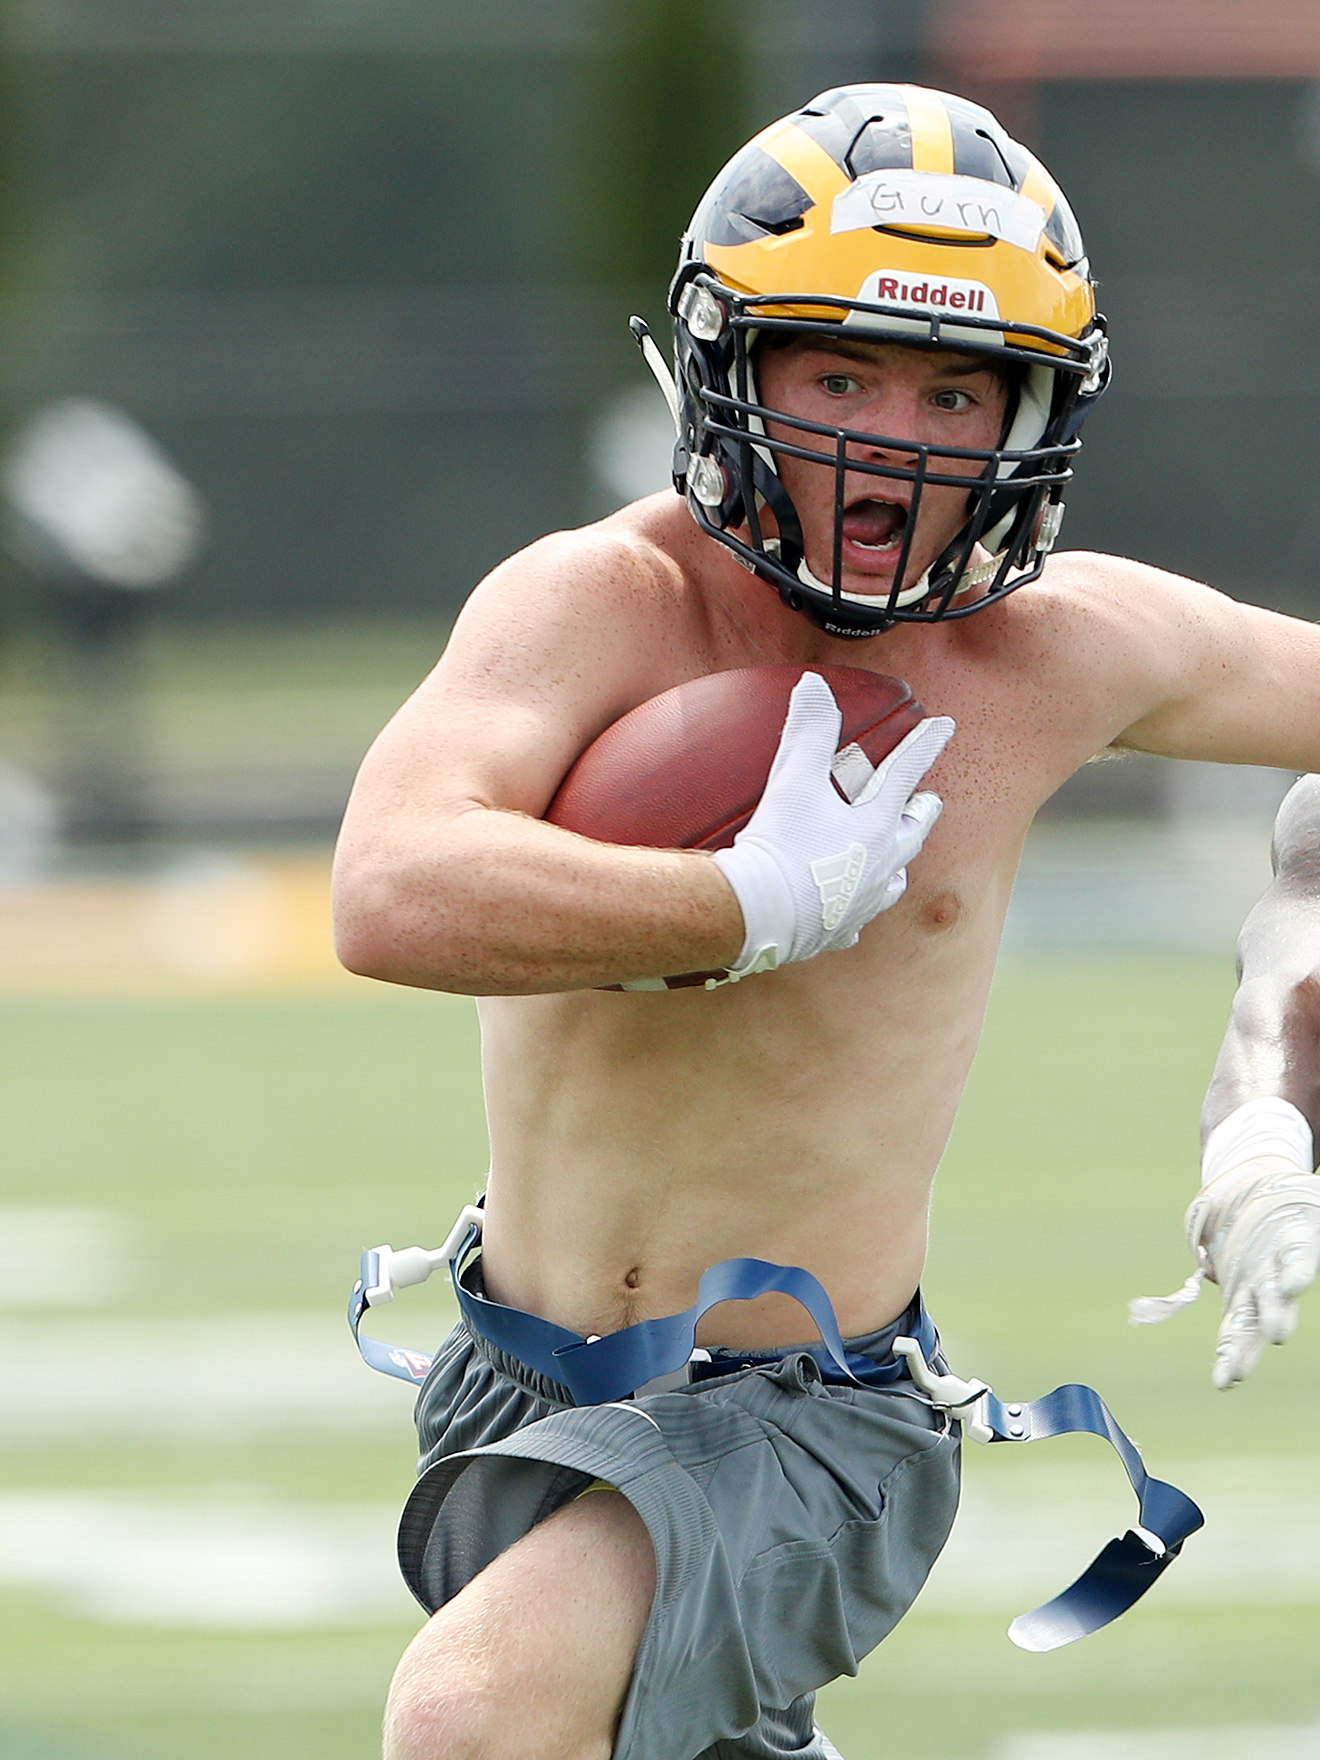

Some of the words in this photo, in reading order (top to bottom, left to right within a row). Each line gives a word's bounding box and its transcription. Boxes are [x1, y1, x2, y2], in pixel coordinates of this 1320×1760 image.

[878, 277, 985, 311] Riddell
[825, 622, 881, 637] Riddell
[823, 846, 864, 929] adidas
